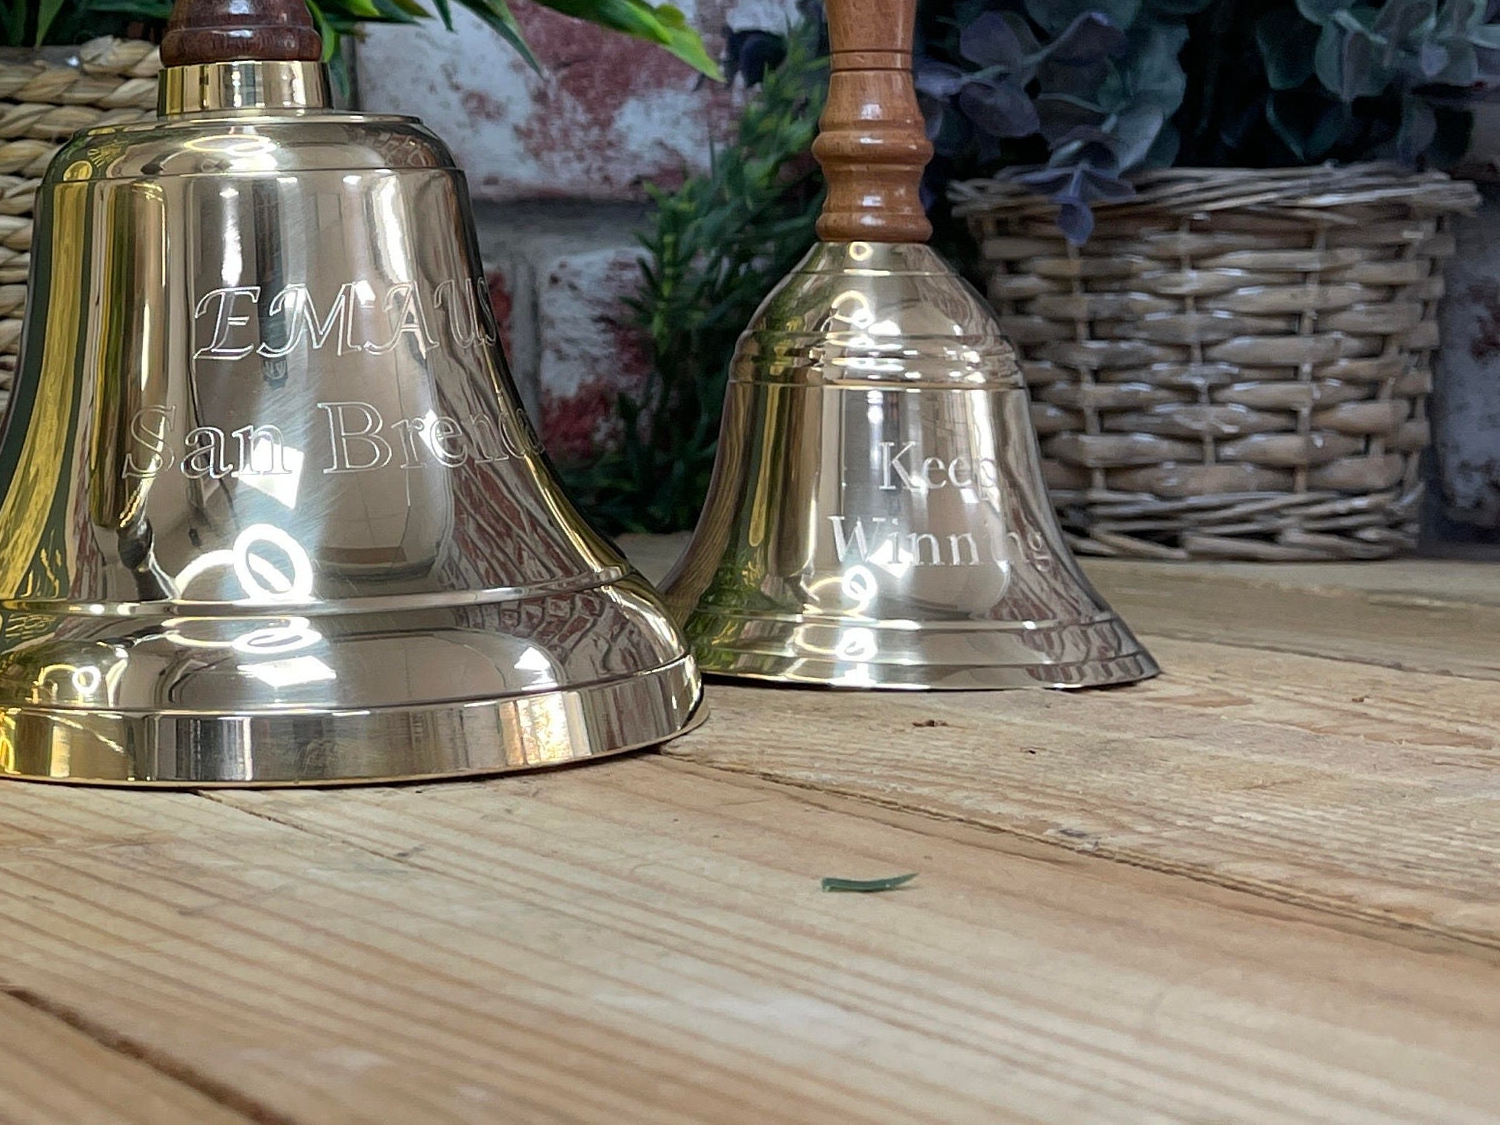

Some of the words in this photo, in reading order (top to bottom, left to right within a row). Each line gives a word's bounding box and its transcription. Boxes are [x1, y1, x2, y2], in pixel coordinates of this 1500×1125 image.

[120, 403, 292, 479] San
[878, 441, 999, 501] Keep
[827, 515, 1052, 573] Winnng
